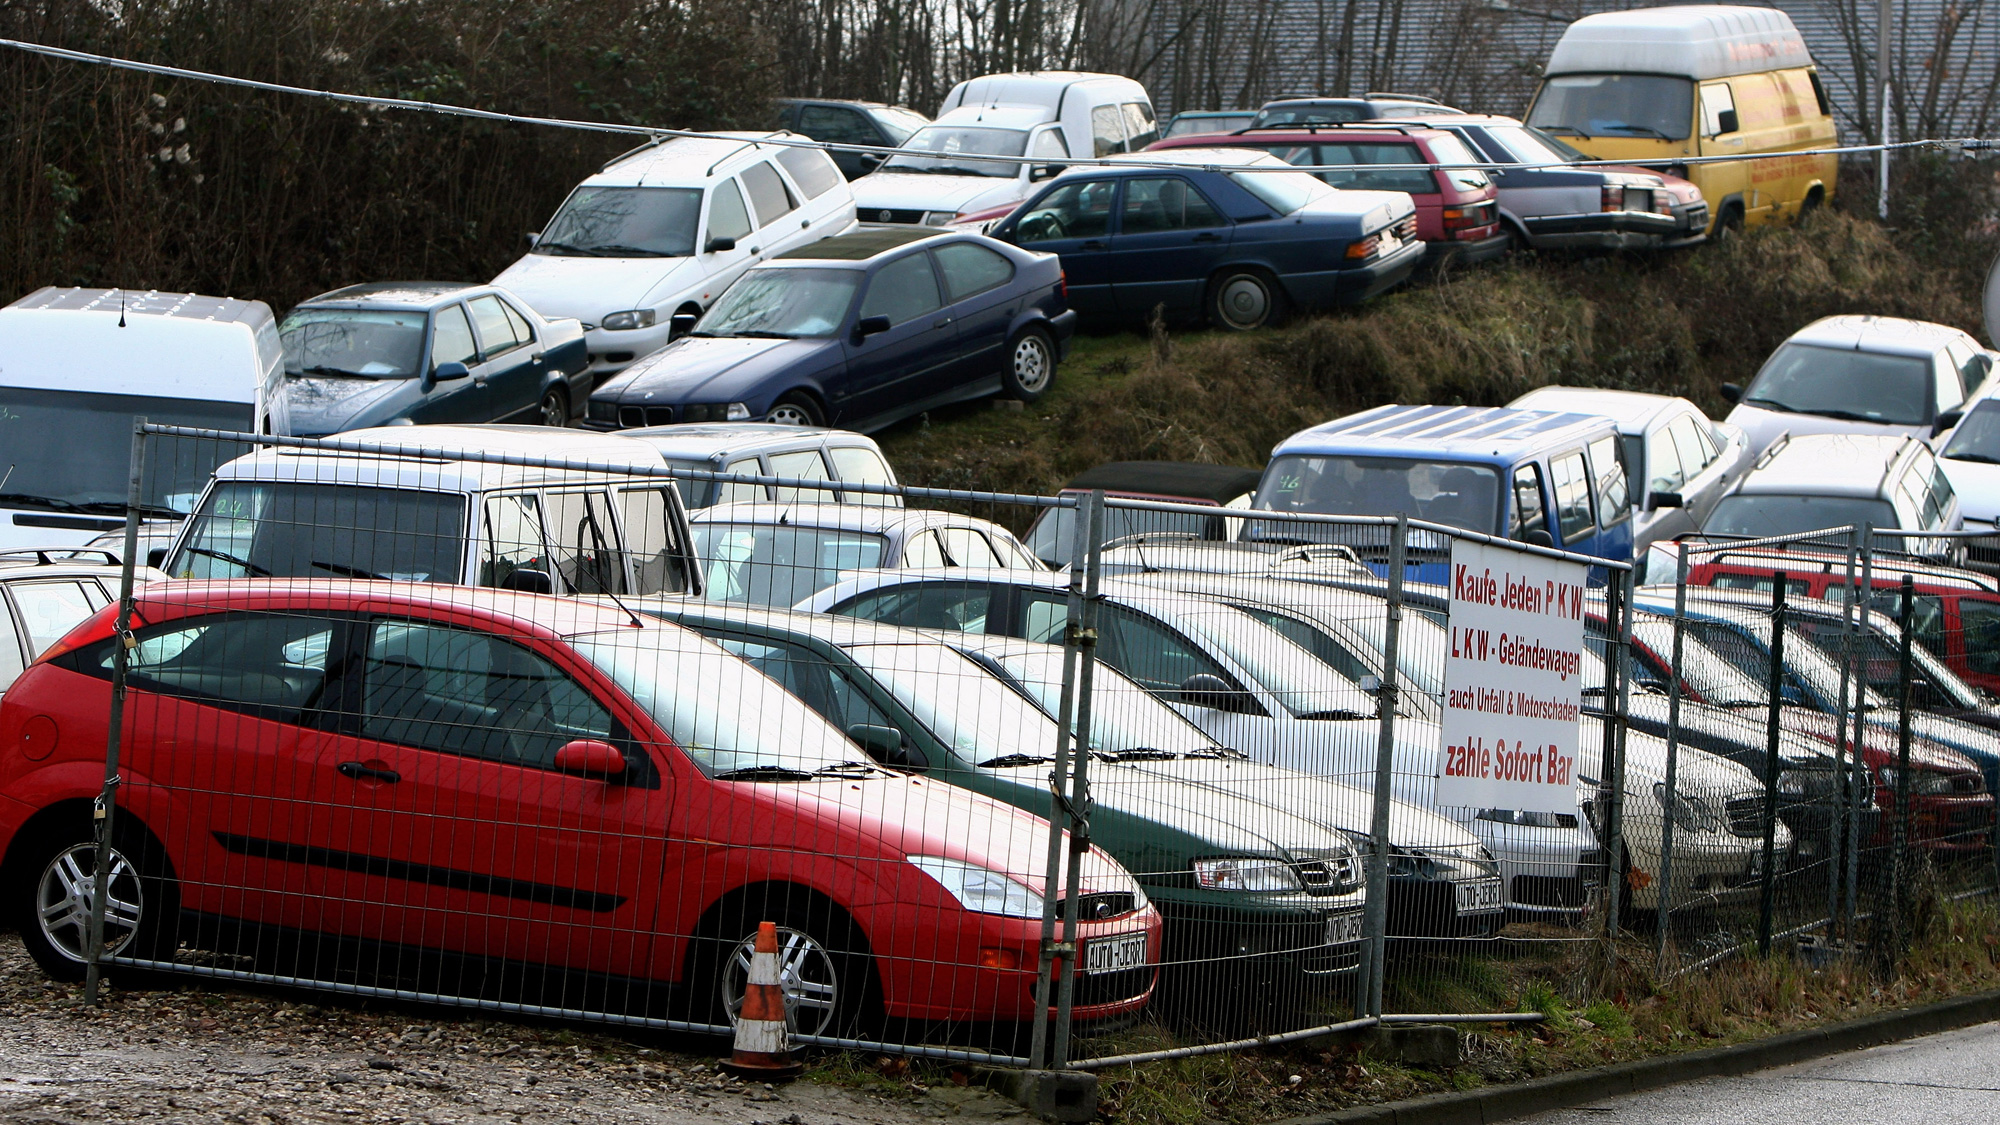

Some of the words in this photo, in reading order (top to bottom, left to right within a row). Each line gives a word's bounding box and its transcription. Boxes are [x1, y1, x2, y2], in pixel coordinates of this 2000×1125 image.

[1454, 563, 1497, 606] Kaufe
[1501, 572, 1541, 614] Jeden
[1499, 632, 1580, 681] Geländewagen
[1449, 686, 1474, 710] auch
[1477, 687, 1505, 714] Unfall
[1507, 691, 1514, 715] &
[1516, 692, 1578, 722] Motorschaden
[1446, 736, 1490, 779] zahle
[1494, 739, 1543, 783] Sofort
[1547, 744, 1573, 785] Bar
